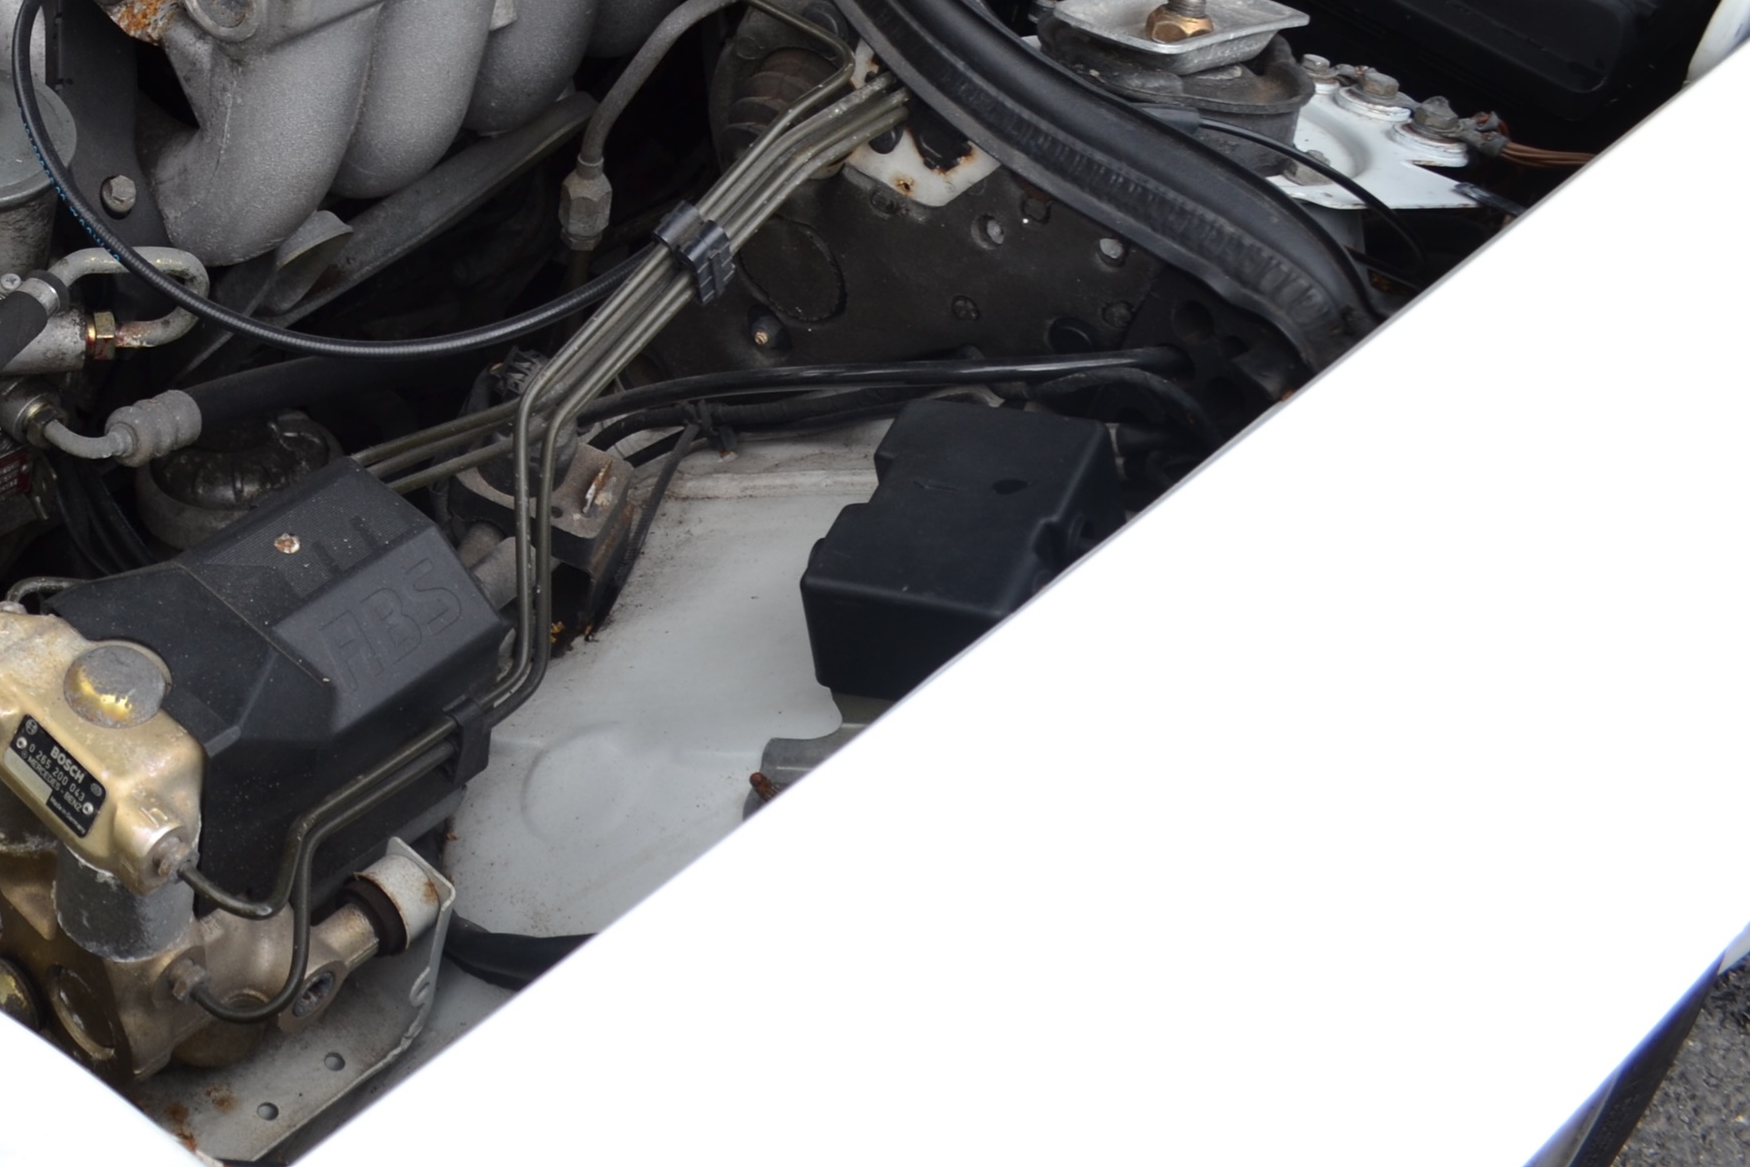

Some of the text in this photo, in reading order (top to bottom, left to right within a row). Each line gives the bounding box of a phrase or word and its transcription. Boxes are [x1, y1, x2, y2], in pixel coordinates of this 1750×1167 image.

[318, 556, 463, 692] ABS
[27, 755, 62, 792] MERCEDES
[36, 750, 52, 770] 265
[52, 767, 69, 786] 200
[69, 783, 86, 802] 043
[49, 745, 85, 784] BOSCH
